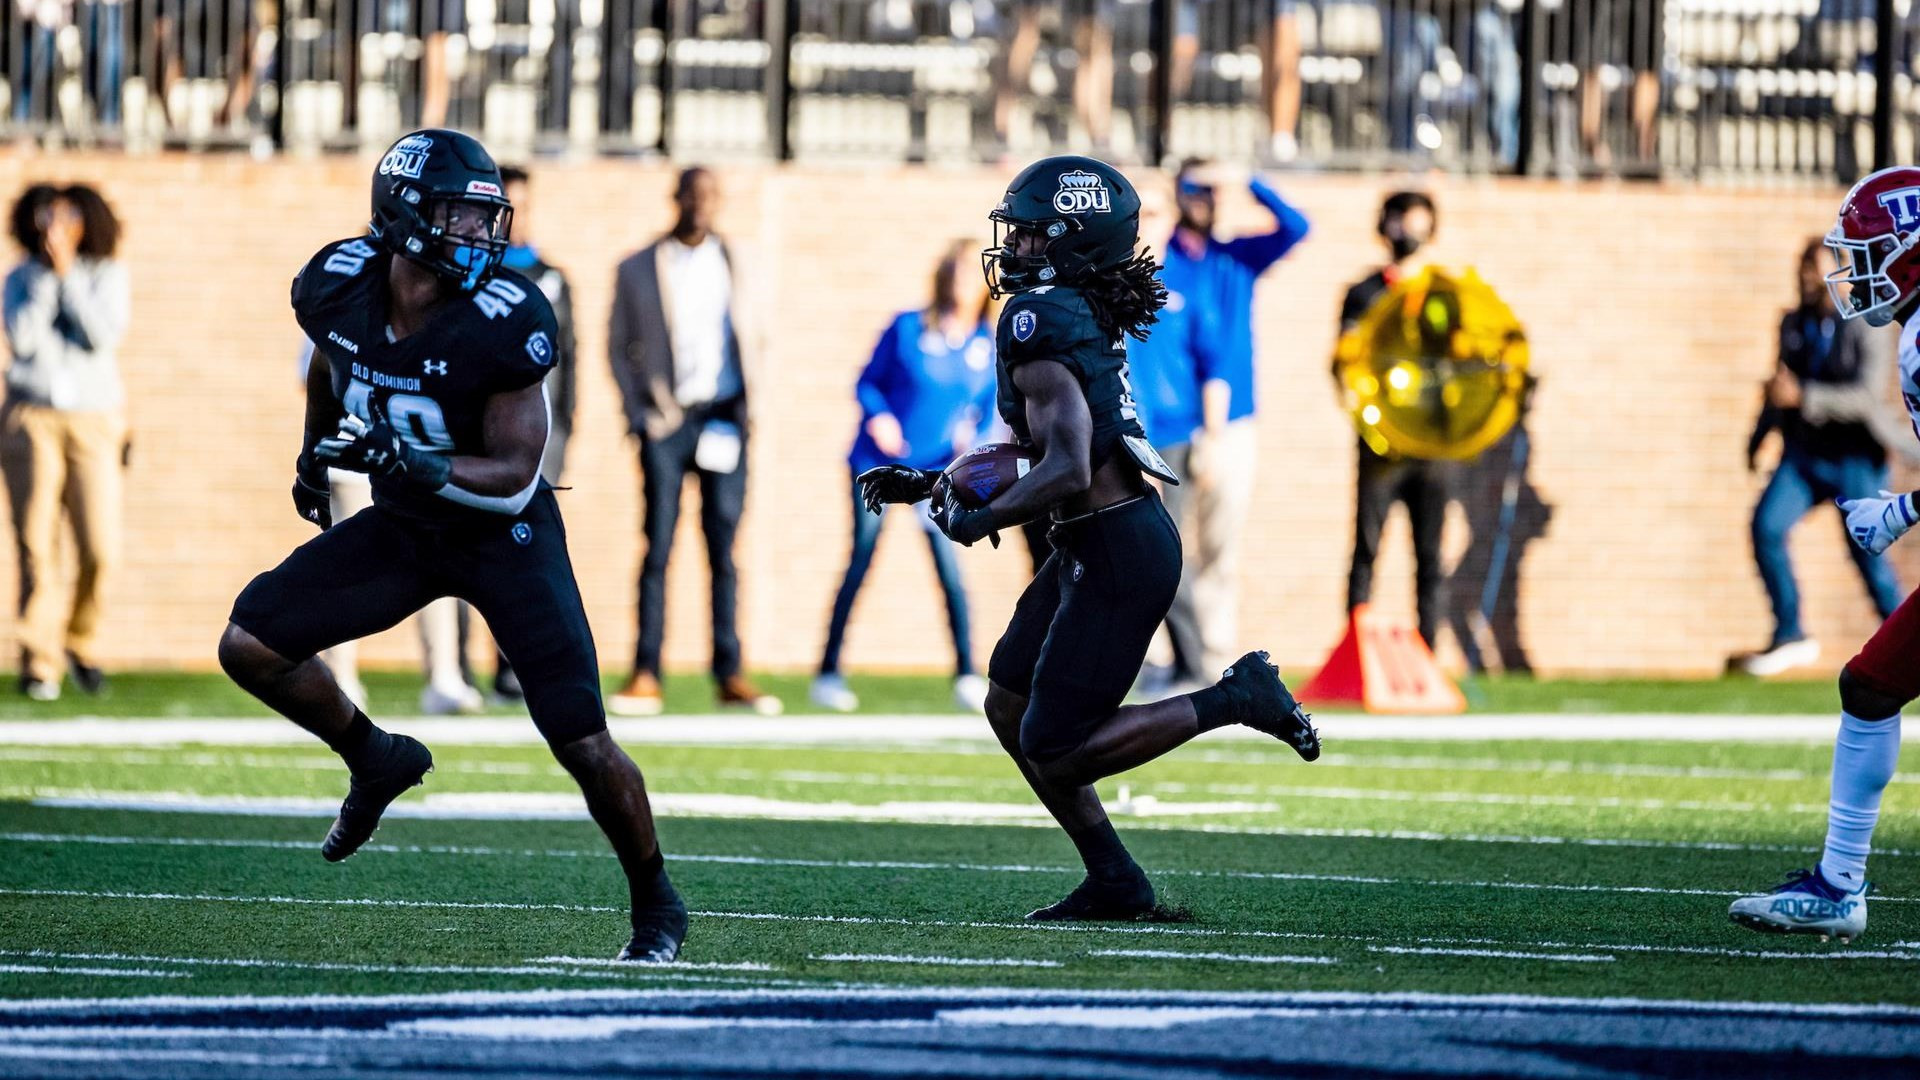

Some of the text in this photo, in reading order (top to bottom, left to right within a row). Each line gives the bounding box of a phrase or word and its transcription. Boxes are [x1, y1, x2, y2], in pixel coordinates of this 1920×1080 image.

[379, 152, 430, 178] ODU
[1053, 188, 1111, 213] ODU
[323, 239, 377, 277] 40
[472, 278, 528, 320] 40
[352, 362, 421, 392] OLD DOMINION
